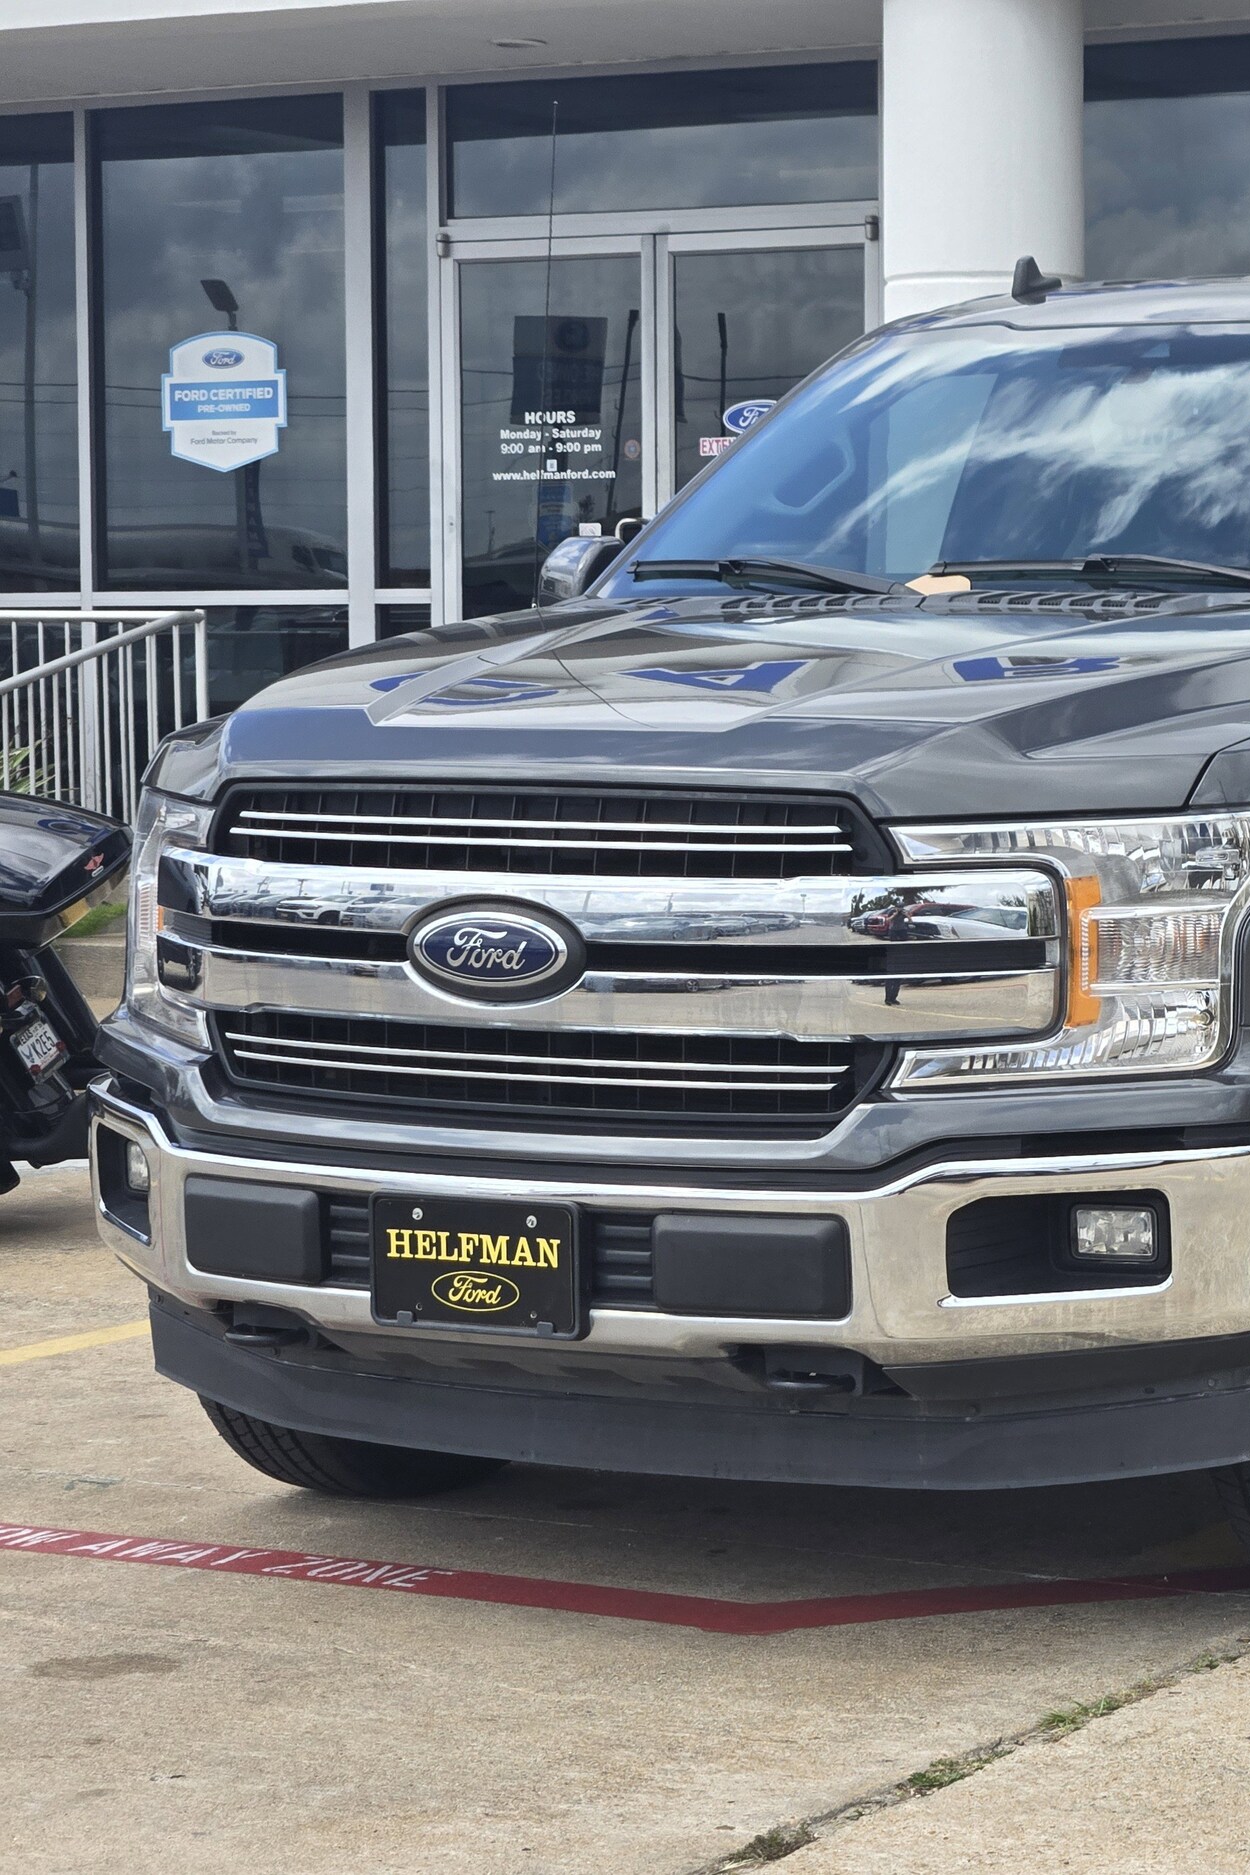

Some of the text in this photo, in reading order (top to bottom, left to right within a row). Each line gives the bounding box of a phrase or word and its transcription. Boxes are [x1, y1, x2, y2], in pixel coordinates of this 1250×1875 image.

[209, 351, 236, 365] Ford
[174, 387, 274, 402] FORD CERTIFIED
[197, 403, 251, 413] PRE-OWNED
[524, 410, 576, 424] HOURS
[190, 437, 206, 445] Ford
[226, 436, 258, 445] Company
[500, 429, 542, 441] Monday
[551, 428, 602, 440] Saturday
[500, 443, 524, 454] 9:00
[528, 445, 546, 453] am
[555, 442, 581, 453] 9:00
[583, 444, 602, 454] pm
[492, 469, 616, 480] www.helfmanford.com
[446, 927, 528, 970] Ford
[386, 1228, 561, 1269] HELFMAN
[448, 1275, 502, 1305] Ford
[0, 1525, 456, 1588] OW AWAY ZONE
